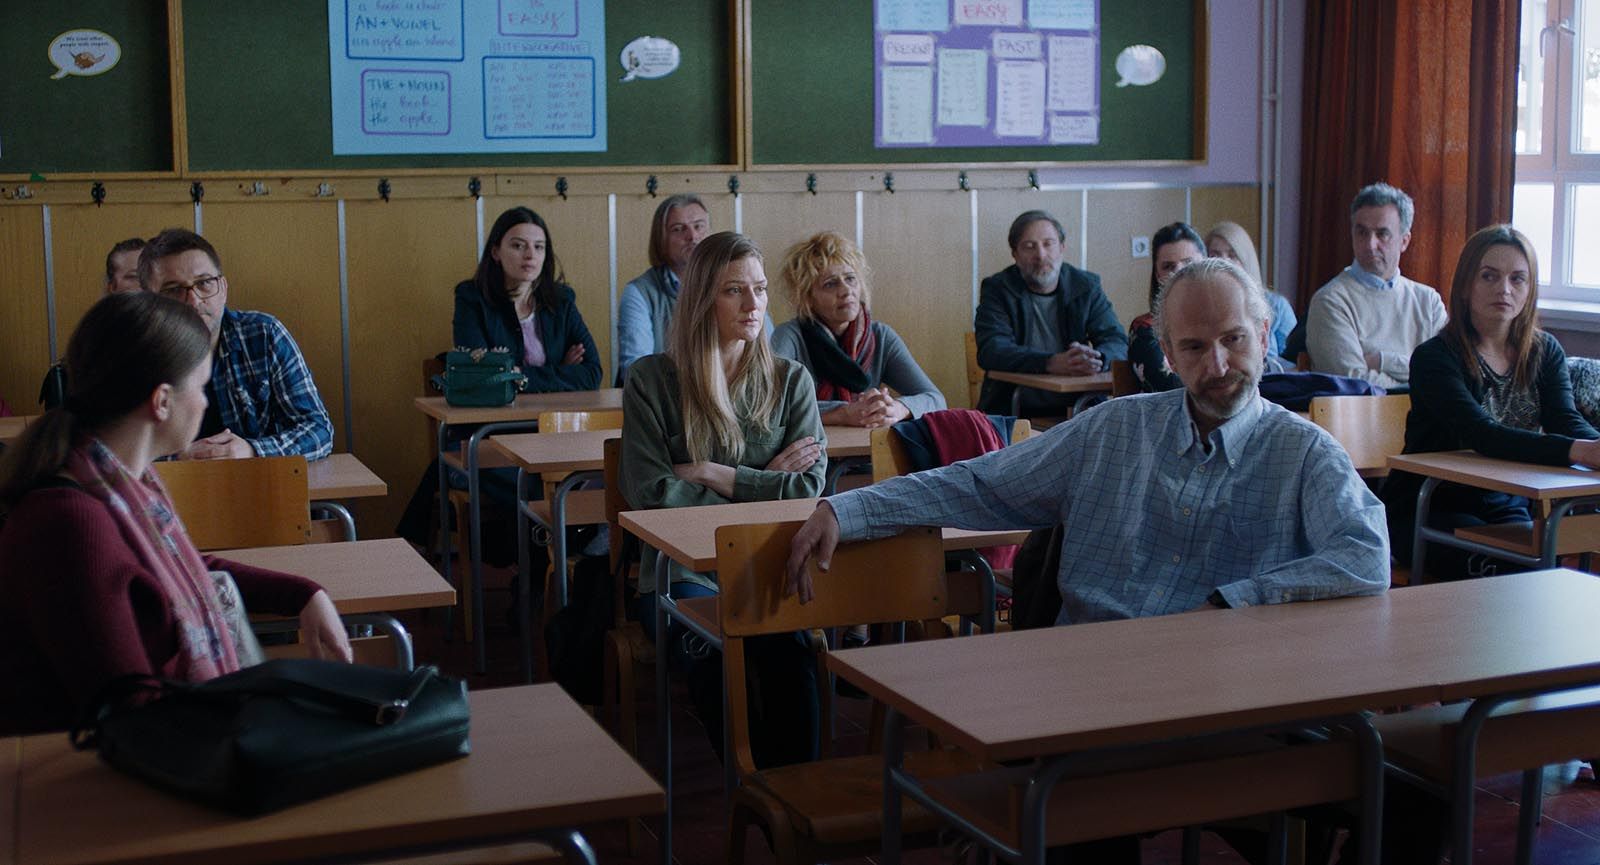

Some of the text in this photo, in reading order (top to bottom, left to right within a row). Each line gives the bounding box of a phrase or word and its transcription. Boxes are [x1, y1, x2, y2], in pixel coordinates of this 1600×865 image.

[963, 4, 1008, 19] EASY
[355, 16, 377, 31] AN
[391, 15, 441, 31] VOWEL
[999, 39, 1034, 55] PAST
[367, 79, 394, 91] THE
